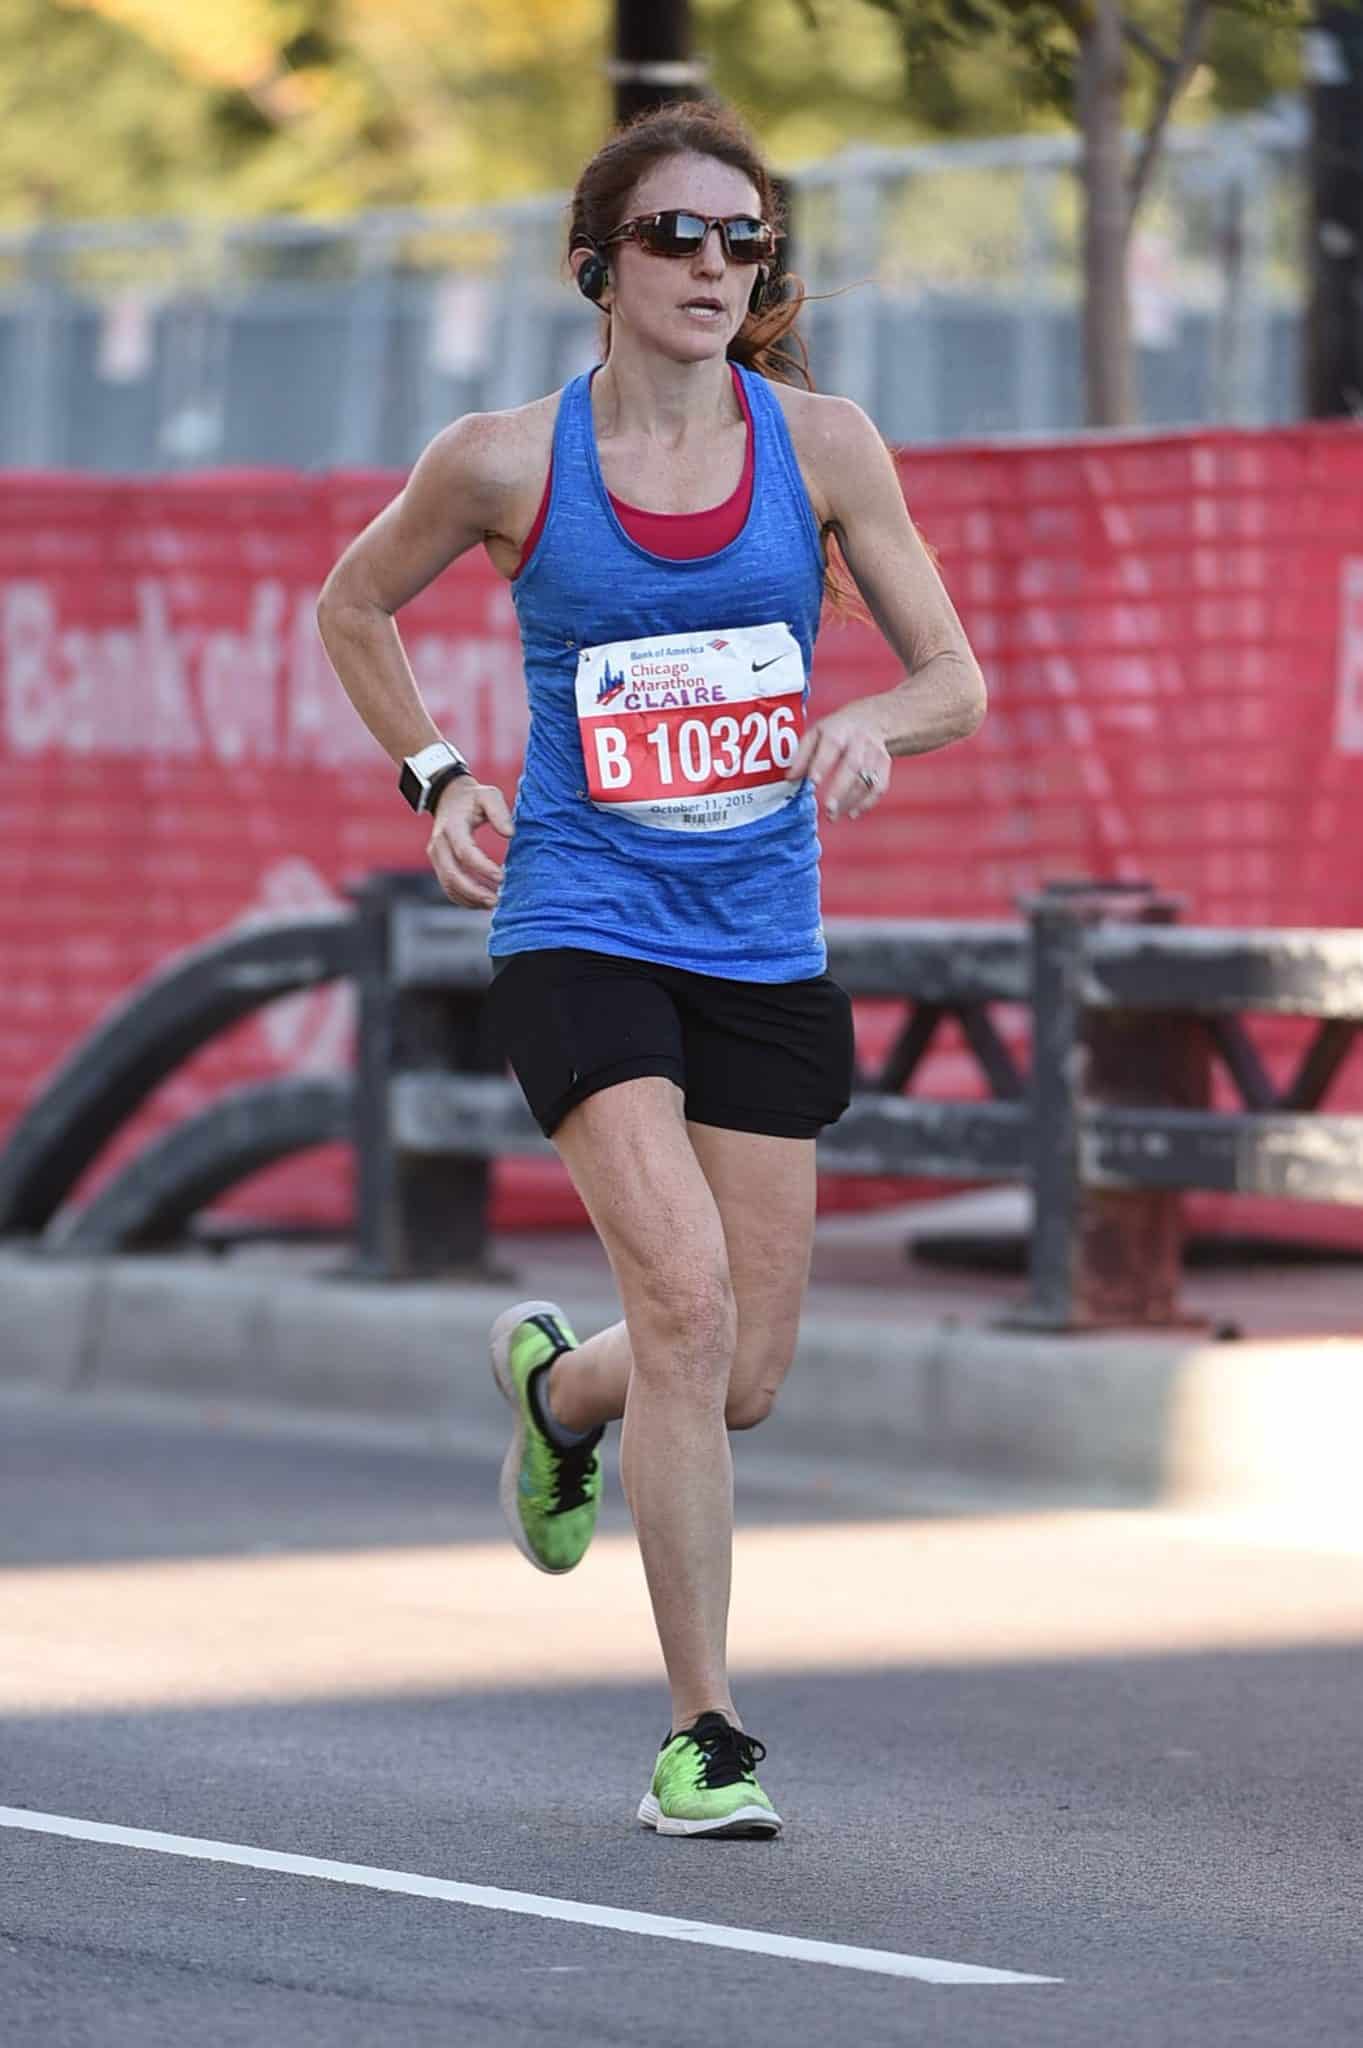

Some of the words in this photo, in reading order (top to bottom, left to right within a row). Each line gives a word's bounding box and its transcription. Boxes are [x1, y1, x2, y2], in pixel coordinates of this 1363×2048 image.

[630, 650, 653, 660] Bank
[654, 648, 665, 657] of
[665, 645, 705, 656] America
[631, 663, 690, 677] Chicago
[632, 677, 705, 692] Marathon
[624, 684, 727, 710] CLAIRE
[594, 726, 633, 789] B
[646, 706, 801, 785] 10326
[650, 804, 700, 815] October
[704, 799, 722, 811] 11,
[725, 793, 754, 808] 2015
